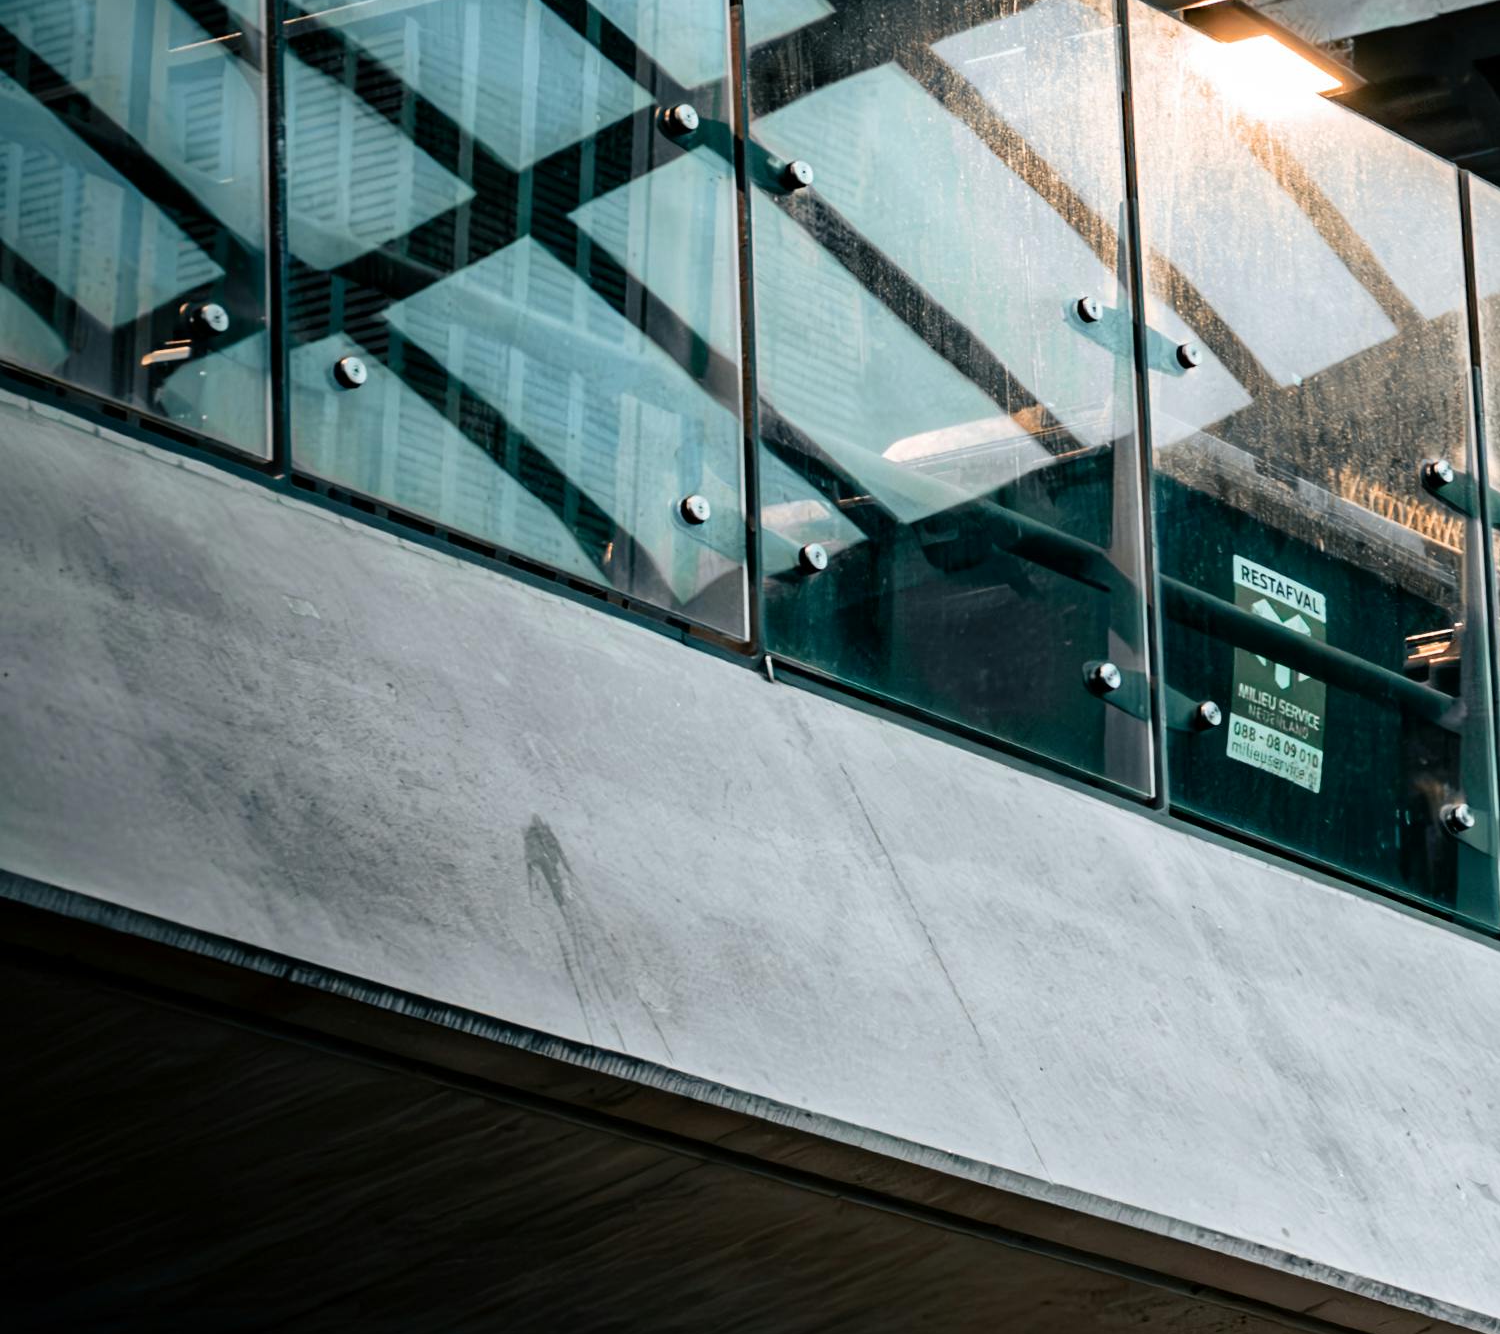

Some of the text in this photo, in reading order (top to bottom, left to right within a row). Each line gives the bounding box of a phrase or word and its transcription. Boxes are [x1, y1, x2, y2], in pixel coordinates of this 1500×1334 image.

[1240, 564, 1321, 616] RESTAFVAL
[1238, 682, 1320, 731] MILIEU SERVICE
